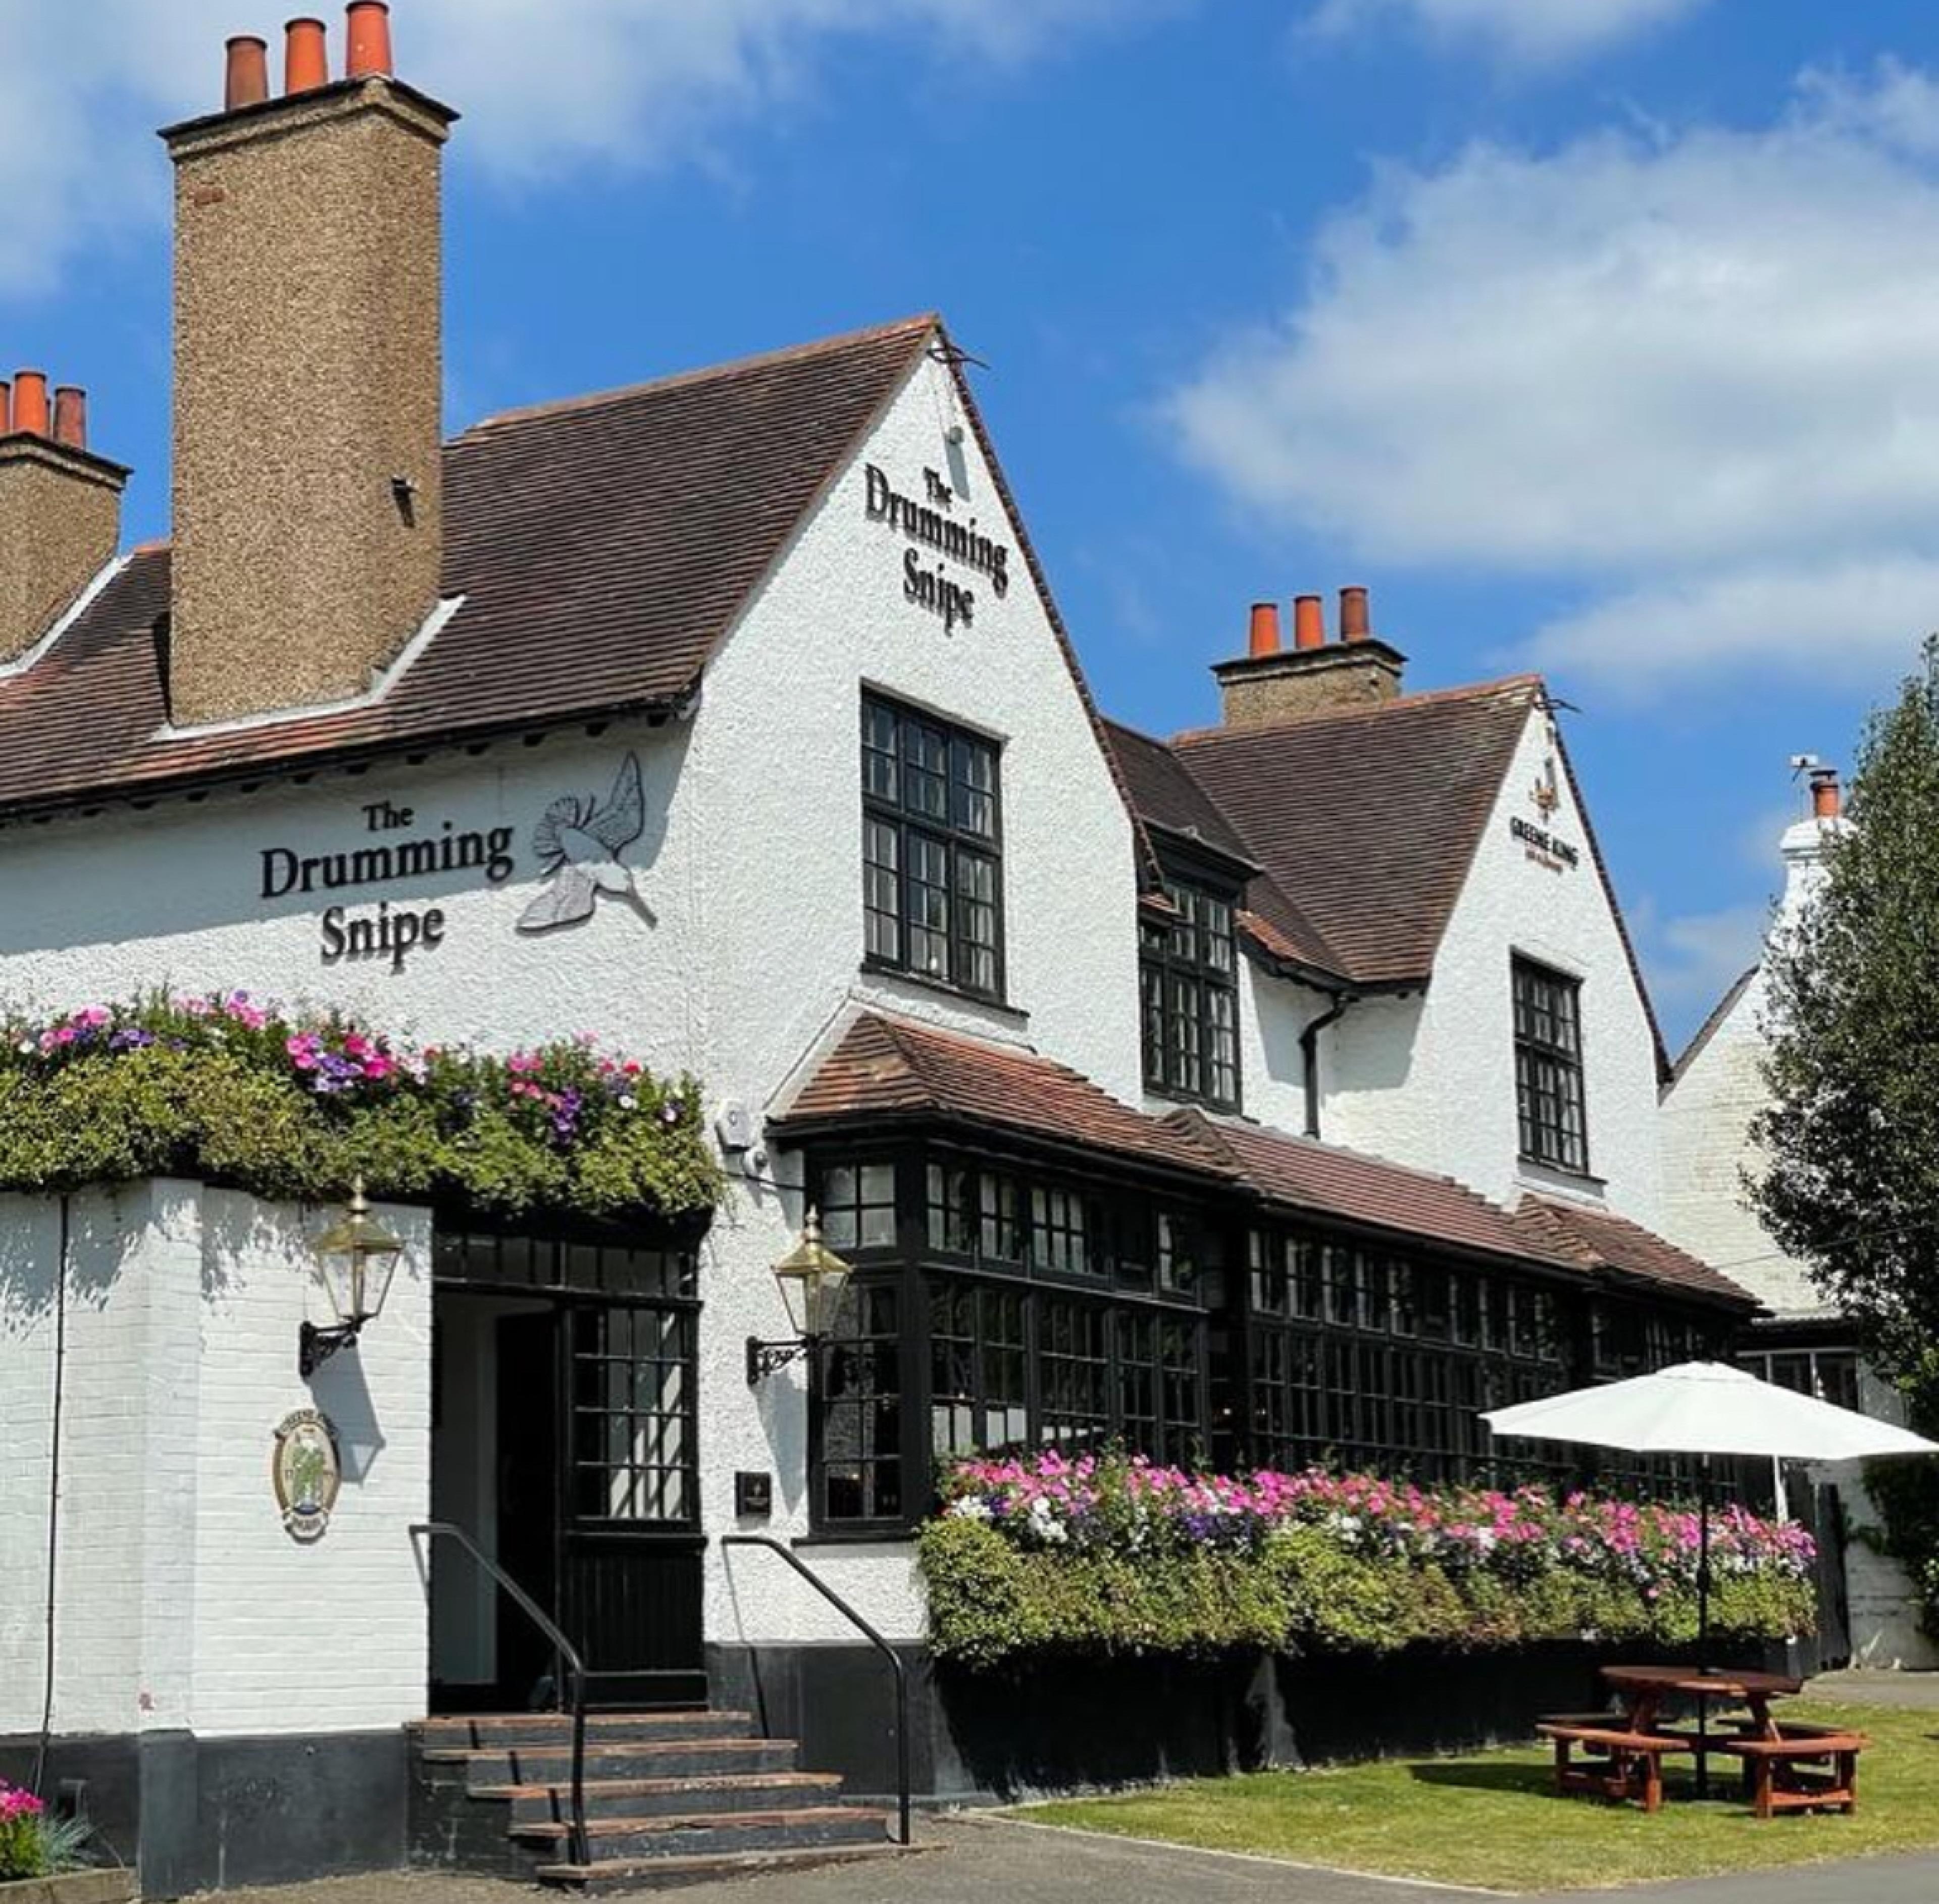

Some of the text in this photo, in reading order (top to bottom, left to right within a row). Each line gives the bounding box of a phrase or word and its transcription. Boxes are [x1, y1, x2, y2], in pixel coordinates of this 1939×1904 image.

[923, 466, 952, 506] The
[865, 462, 1009, 599] Drumming
[903, 548, 975, 636] Snipe
[361, 800, 414, 831] The
[260, 821, 514, 898] Drumming
[321, 901, 444, 974] Snipe
